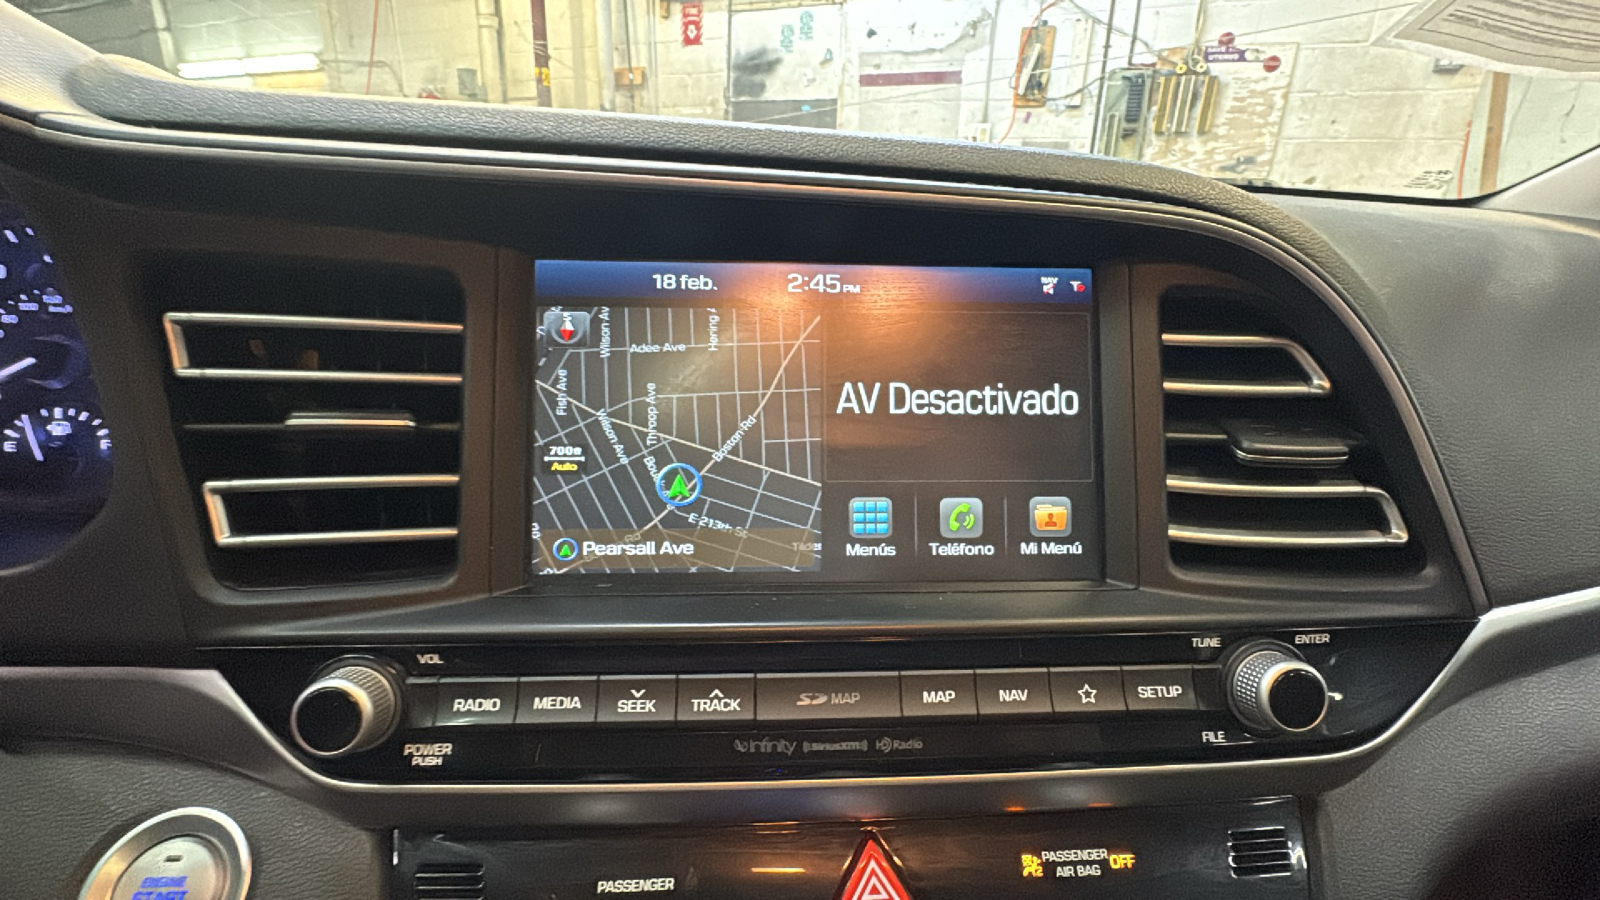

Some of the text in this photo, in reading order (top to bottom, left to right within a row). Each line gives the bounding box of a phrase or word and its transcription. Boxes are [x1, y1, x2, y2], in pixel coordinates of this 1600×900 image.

[653, 274, 718, 291] 18 feb.
[787, 273, 861, 294] 2:45 PM
[599, 323, 611, 358] Wilson
[629, 343, 686, 353] Adee Ave
[645, 382, 657, 404] Ave
[836, 381, 1079, 416] AV Desactivado
[711, 414, 758, 462] Boston Rd
[3, 441, 18, 452] E
[550, 461, 579, 471] Auto
[687, 512, 699, 523] E
[582, 541, 695, 556] Pearsall Ave
[845, 543, 897, 557] Menús
[928, 542, 995, 556] Teléfono
[1020, 542, 1083, 556] Mi Menú
[1191, 637, 1222, 648] TUNE
[1294, 633, 1330, 645] ENTER
[416, 653, 444, 665] VOL
[831, 692, 861, 705] MAP
[922, 690, 956, 704] MAP
[998, 688, 1028, 703] NAV
[1137, 685, 1183, 699] SETUP
[452, 698, 501, 713] RADIO
[532, 696, 582, 710] MEDIA
[617, 699, 656, 713] SEEK
[691, 698, 741, 712] TRACK
[892, 738, 924, 750] Radio
[1201, 731, 1227, 743] FILE
[403, 743, 453, 756] POWER
[411, 756, 443, 766] PUSH
[1041, 849, 1136, 869] PASSENGER OFF
[1056, 864, 1102, 878] AIR BAG
[597, 877, 675, 893] PASSENGER
